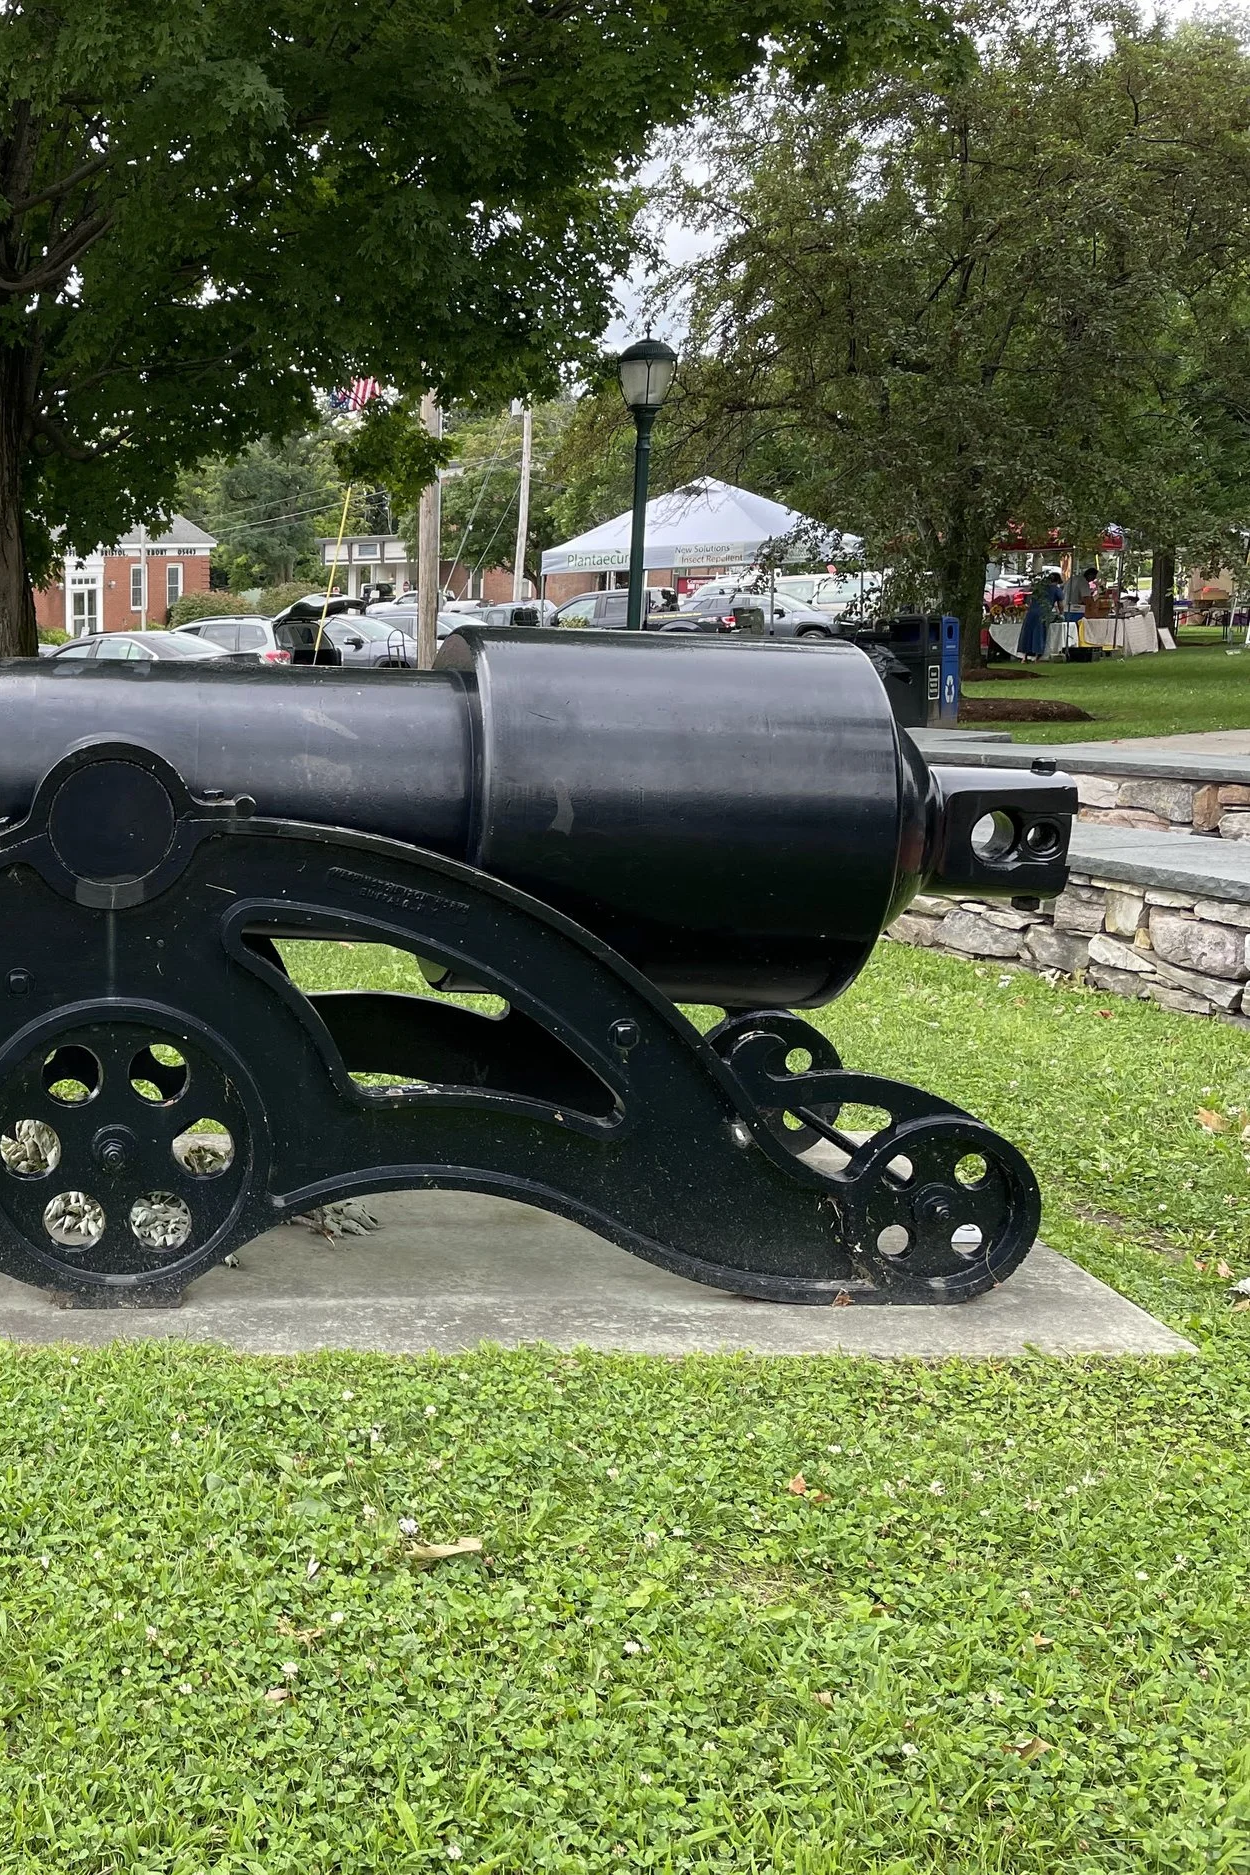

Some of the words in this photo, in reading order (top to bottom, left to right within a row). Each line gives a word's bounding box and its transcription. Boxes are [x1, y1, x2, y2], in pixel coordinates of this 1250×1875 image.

[567, 551, 630, 567] Plantaecur
[681, 556, 704, 564] Insect
[706, 554, 743, 563] Repellent
